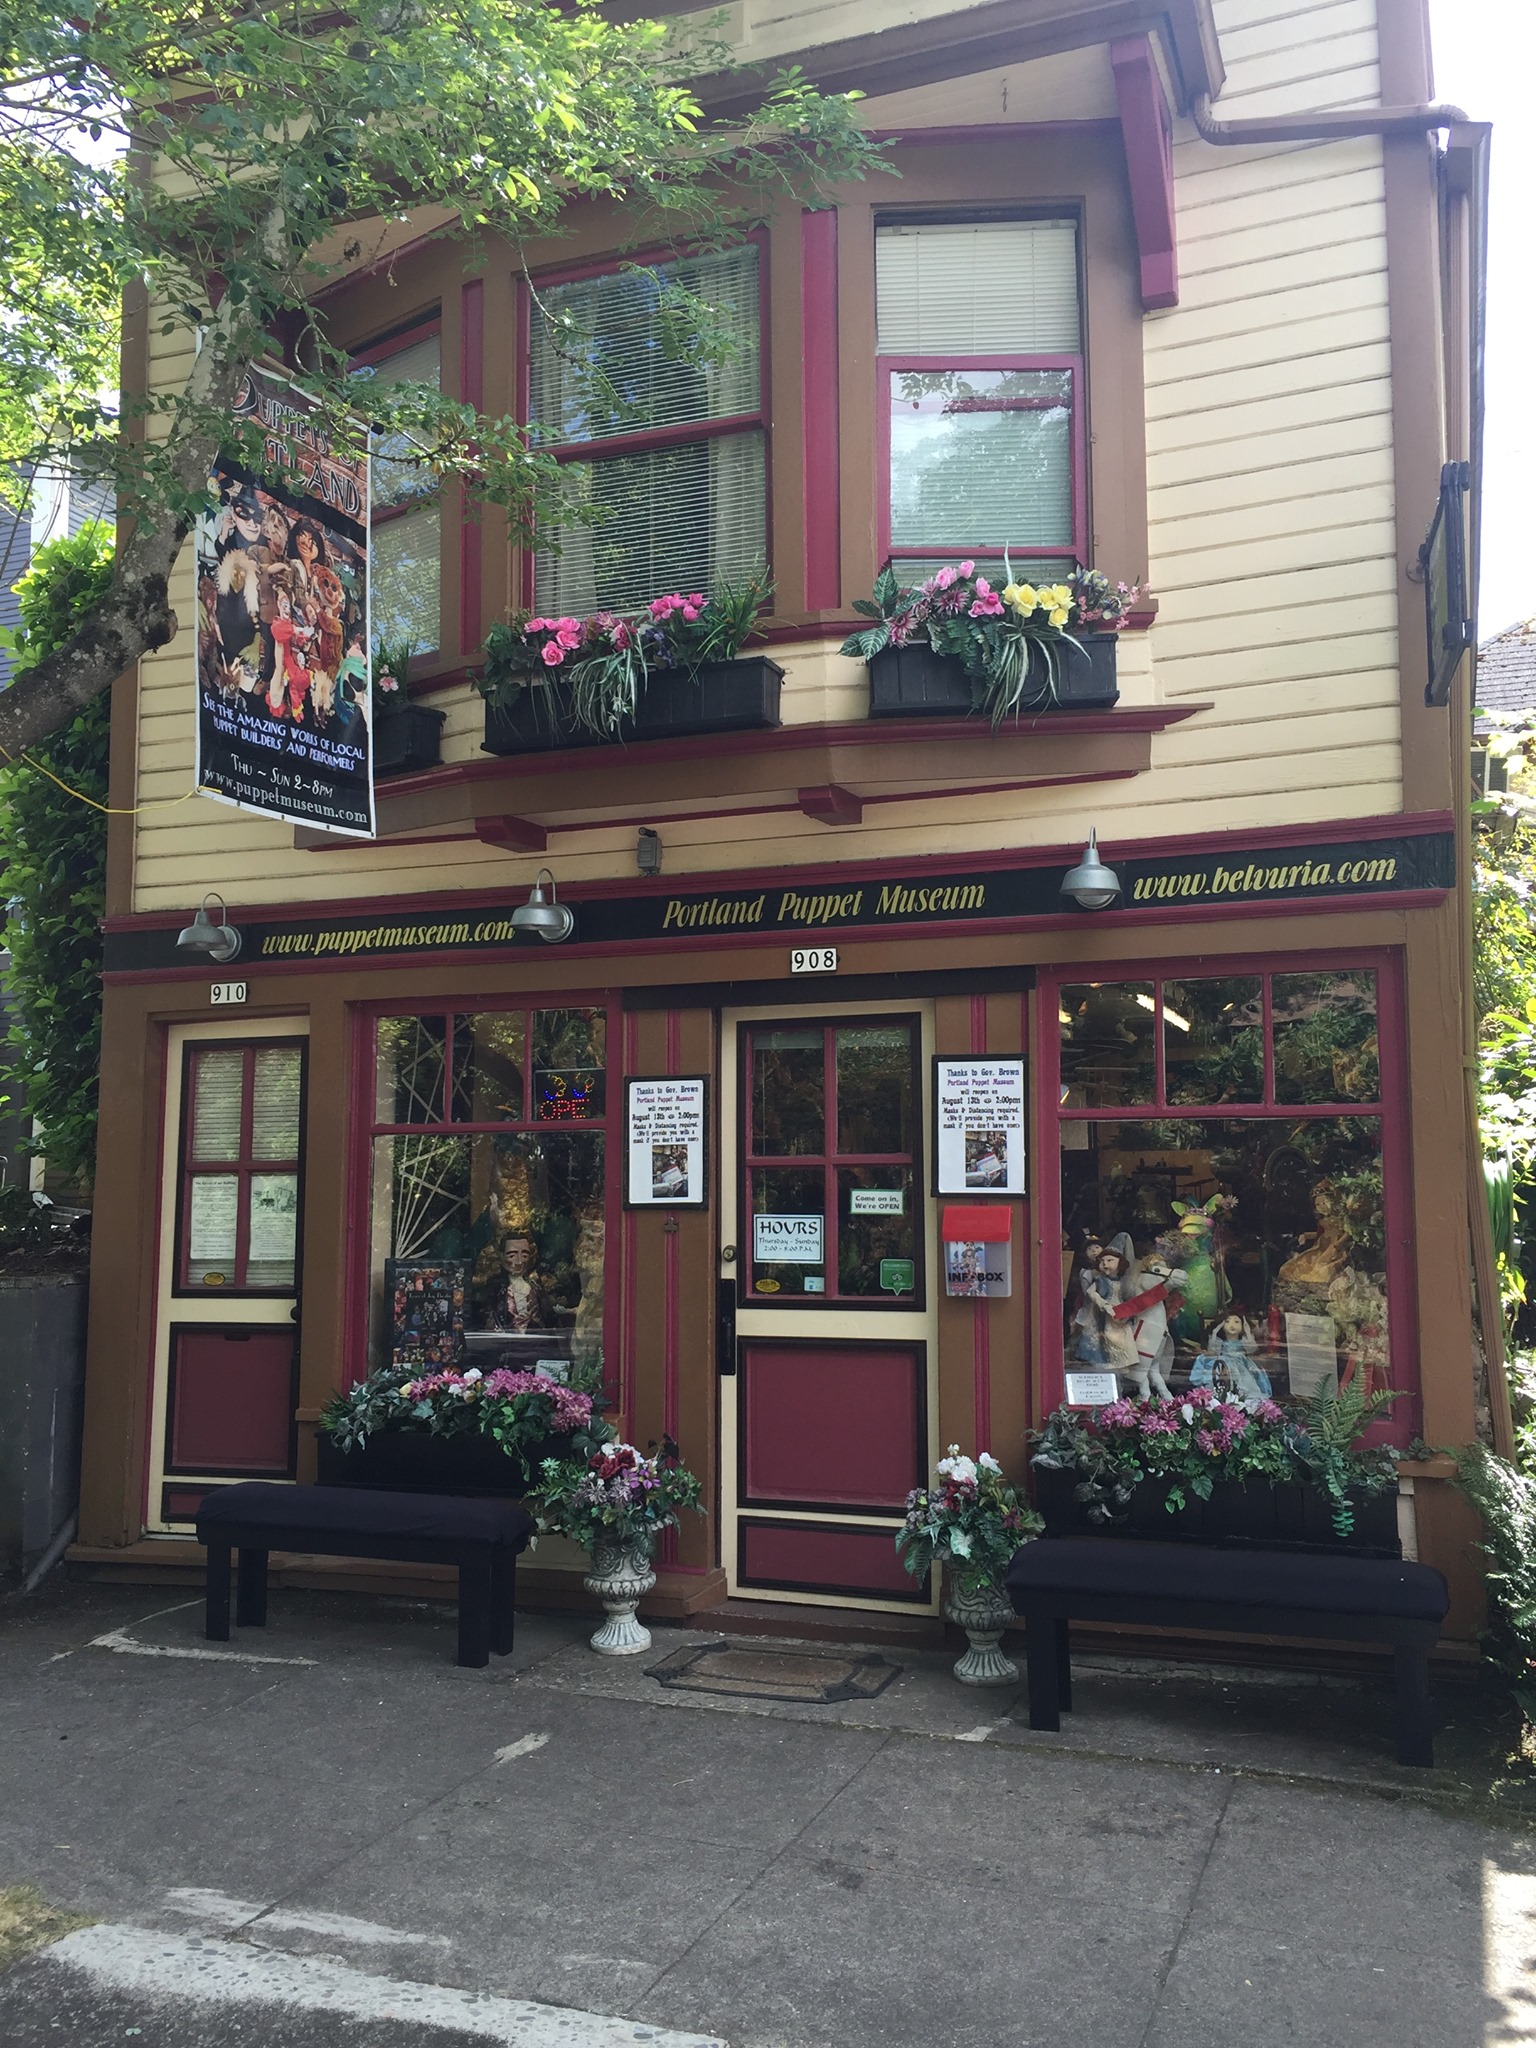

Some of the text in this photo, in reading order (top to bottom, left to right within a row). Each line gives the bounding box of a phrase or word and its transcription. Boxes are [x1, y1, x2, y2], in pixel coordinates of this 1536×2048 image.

[217, 704, 234, 721] THE
[236, 712, 287, 737] AMAZING
[290, 726, 318, 747] WORKS
[320, 738, 330, 751] OF
[331, 741, 366, 760] LOCAL
[213, 715, 356, 771] PUPPET BUILDERS AND PERFORMERS
[203, 769, 368, 824] www.puppetmuseum.com
[1133, 857, 1397, 901] www.belvuria.com
[662, 883, 986, 929] Portland Puppet Museum
[261, 921, 516, 956] www.puppetmuseum.com
[793, 951, 835, 970] 908
[213, 984, 244, 1002] 910
[947, 1069, 968, 1077] Thanks
[981, 1068, 995, 1076] Gov.
[998, 1068, 1020, 1076] Brown
[972, 1079, 990, 1087] Puppet
[636, 1087, 655, 1095] Thanks
[665, 1086, 678, 1094] Gov.
[680, 1085, 699, 1093] Brown
[942, 1096, 963, 1106] August
[968, 1106, 994, 1115] Distancing
[632, 1113, 650, 1123] August
[655, 1122, 677, 1130] Distancing
[965, 1122, 974, 1130] you
[855, 1194, 876, 1202] Come
[878, 1202, 900, 1210] OPEN
[759, 1221, 818, 1235] HOURS
[758, 1237, 788, 1245] Thursday
[794, 1237, 820, 1246] Sunday
